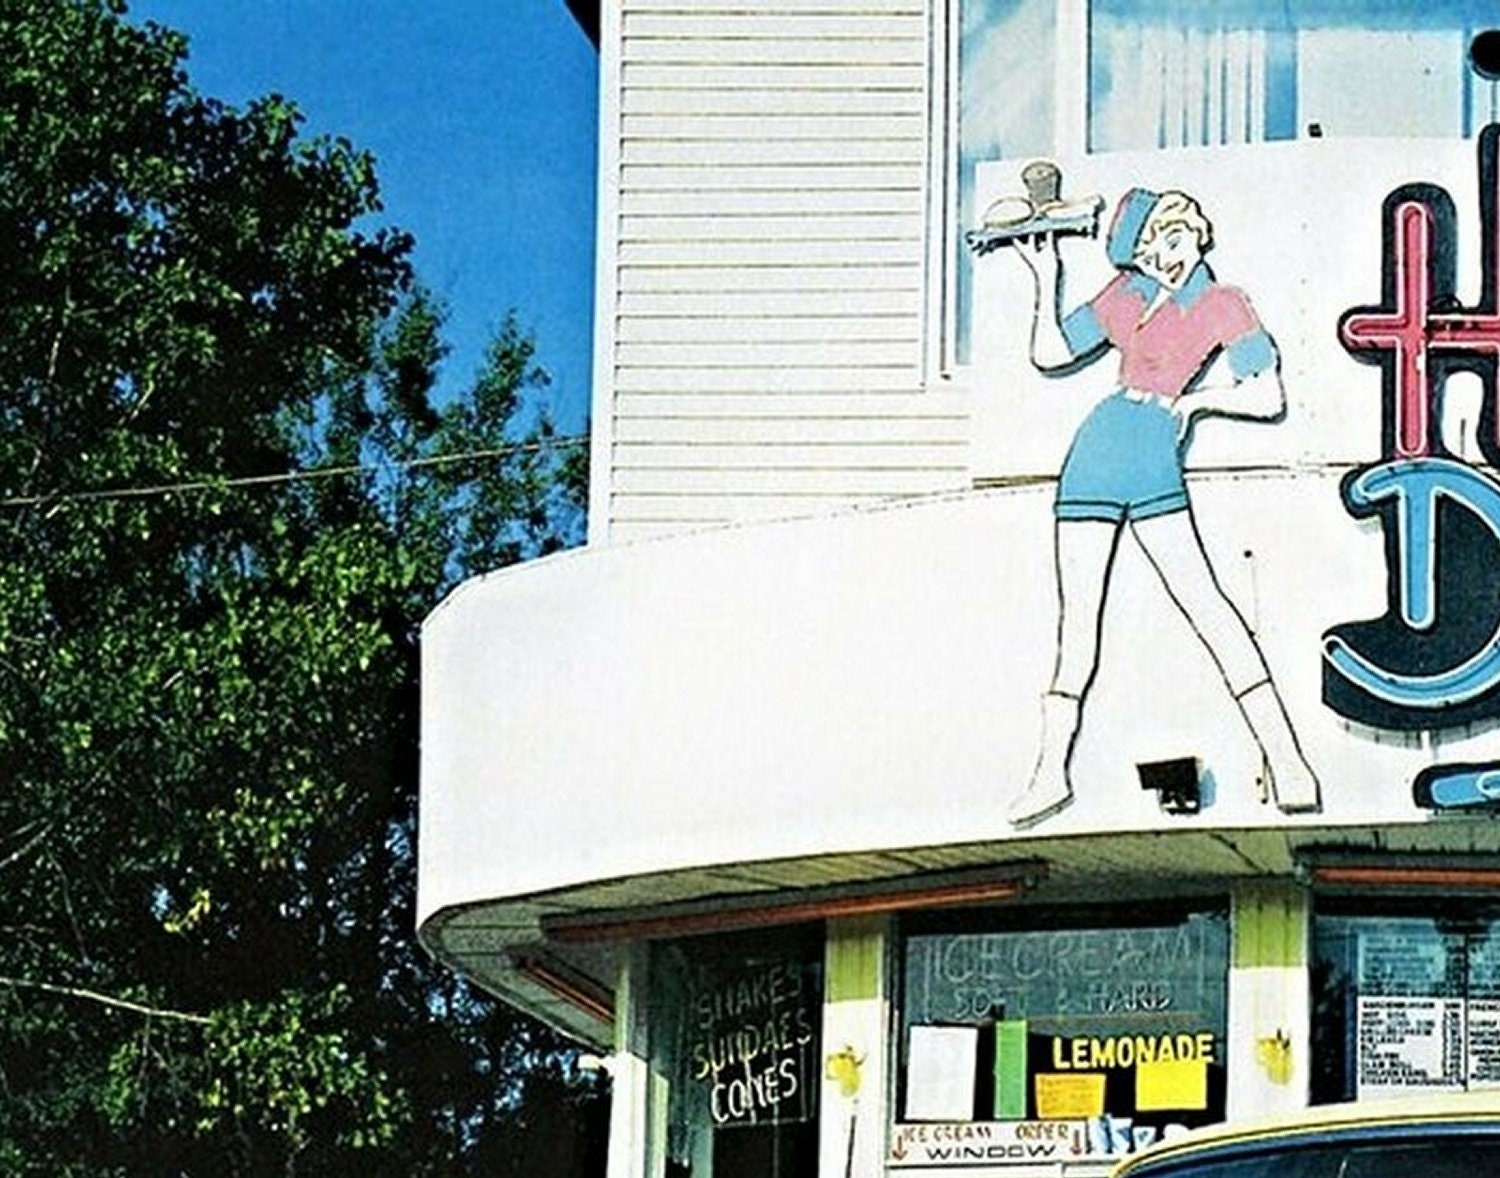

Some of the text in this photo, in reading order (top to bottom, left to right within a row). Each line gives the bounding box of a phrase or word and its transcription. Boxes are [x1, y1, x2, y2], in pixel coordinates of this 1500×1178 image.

[931, 931, 1192, 983] ICE CREAM
[698, 963, 803, 1031] SHAKES
[1086, 980, 1172, 1013] HARD
[693, 1008, 812, 1080] SUNDAES
[1052, 1034, 1215, 1070] LEMONADE
[711, 1058, 798, 1122] CONES
[925, 1144, 1056, 1160] WINDOW
[932, 1124, 992, 1142] CREAM
[1015, 1122, 1070, 1140] ORDER
